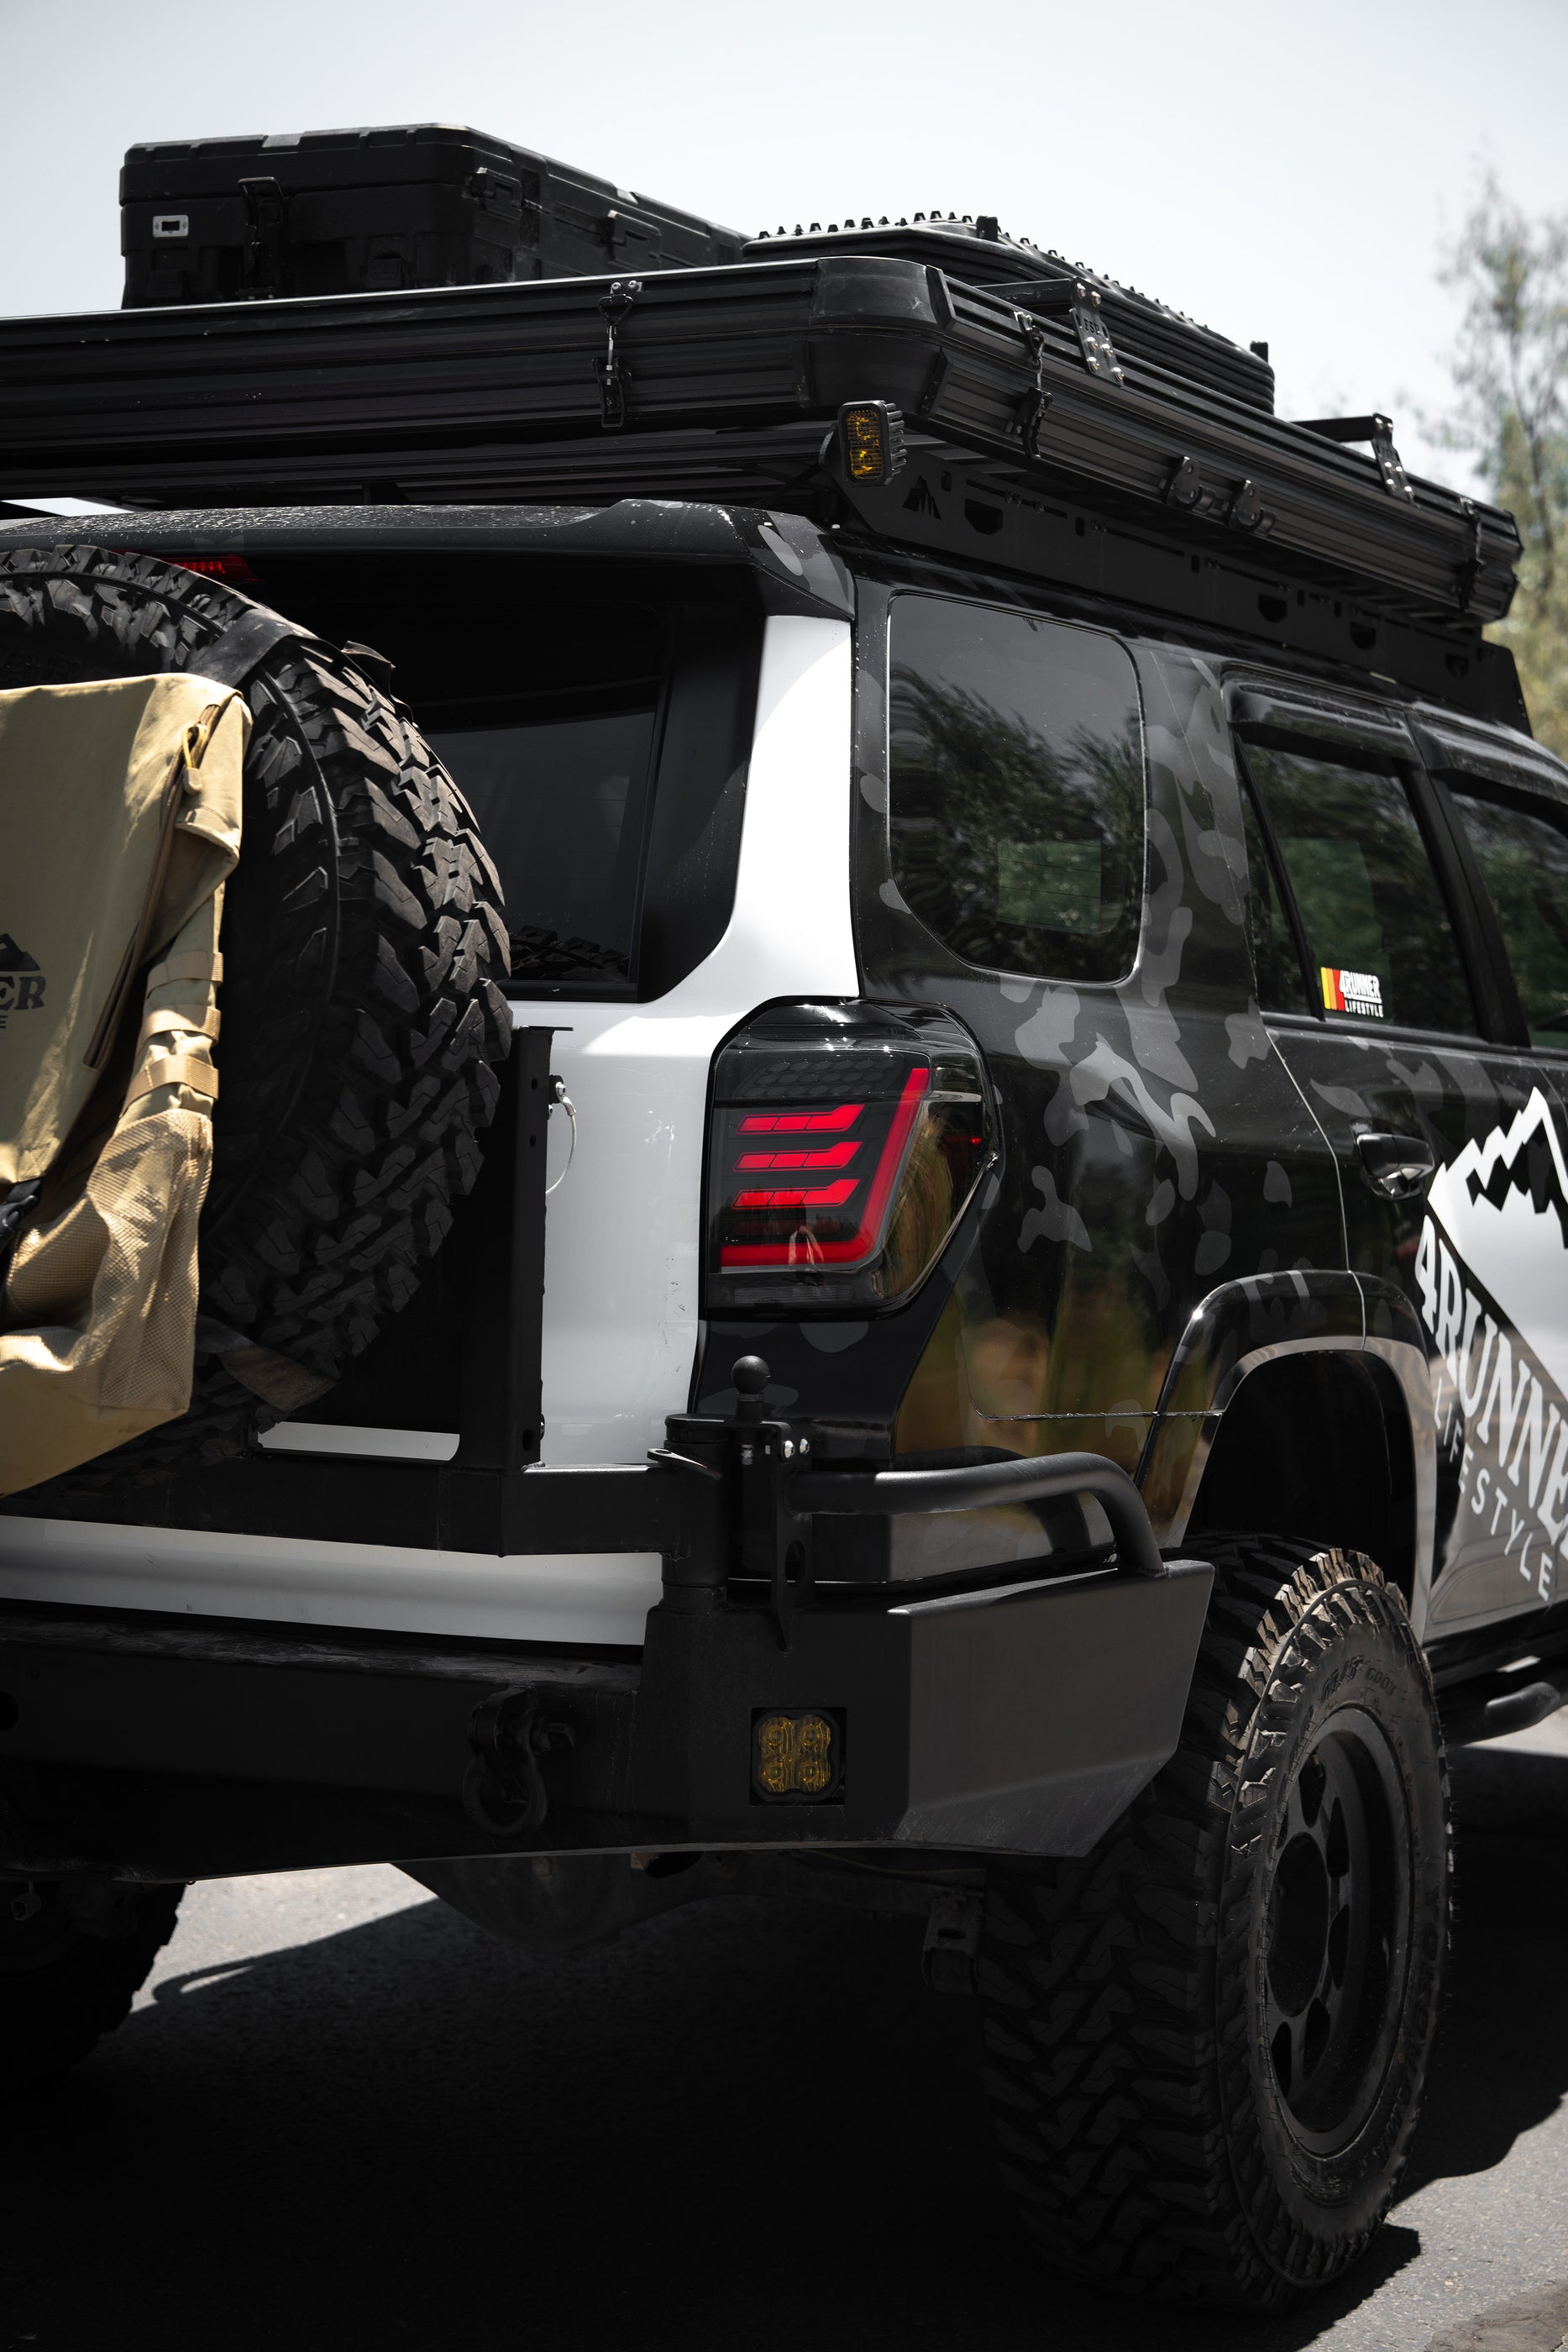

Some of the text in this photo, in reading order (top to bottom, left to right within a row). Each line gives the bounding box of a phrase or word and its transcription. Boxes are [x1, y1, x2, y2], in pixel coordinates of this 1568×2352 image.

[1345, 999, 1384, 1018] LIFESTYLE
[1415, 1215, 1568, 1561] 4RUNNE
[1434, 1377, 1553, 1602] LIFESTYLE
